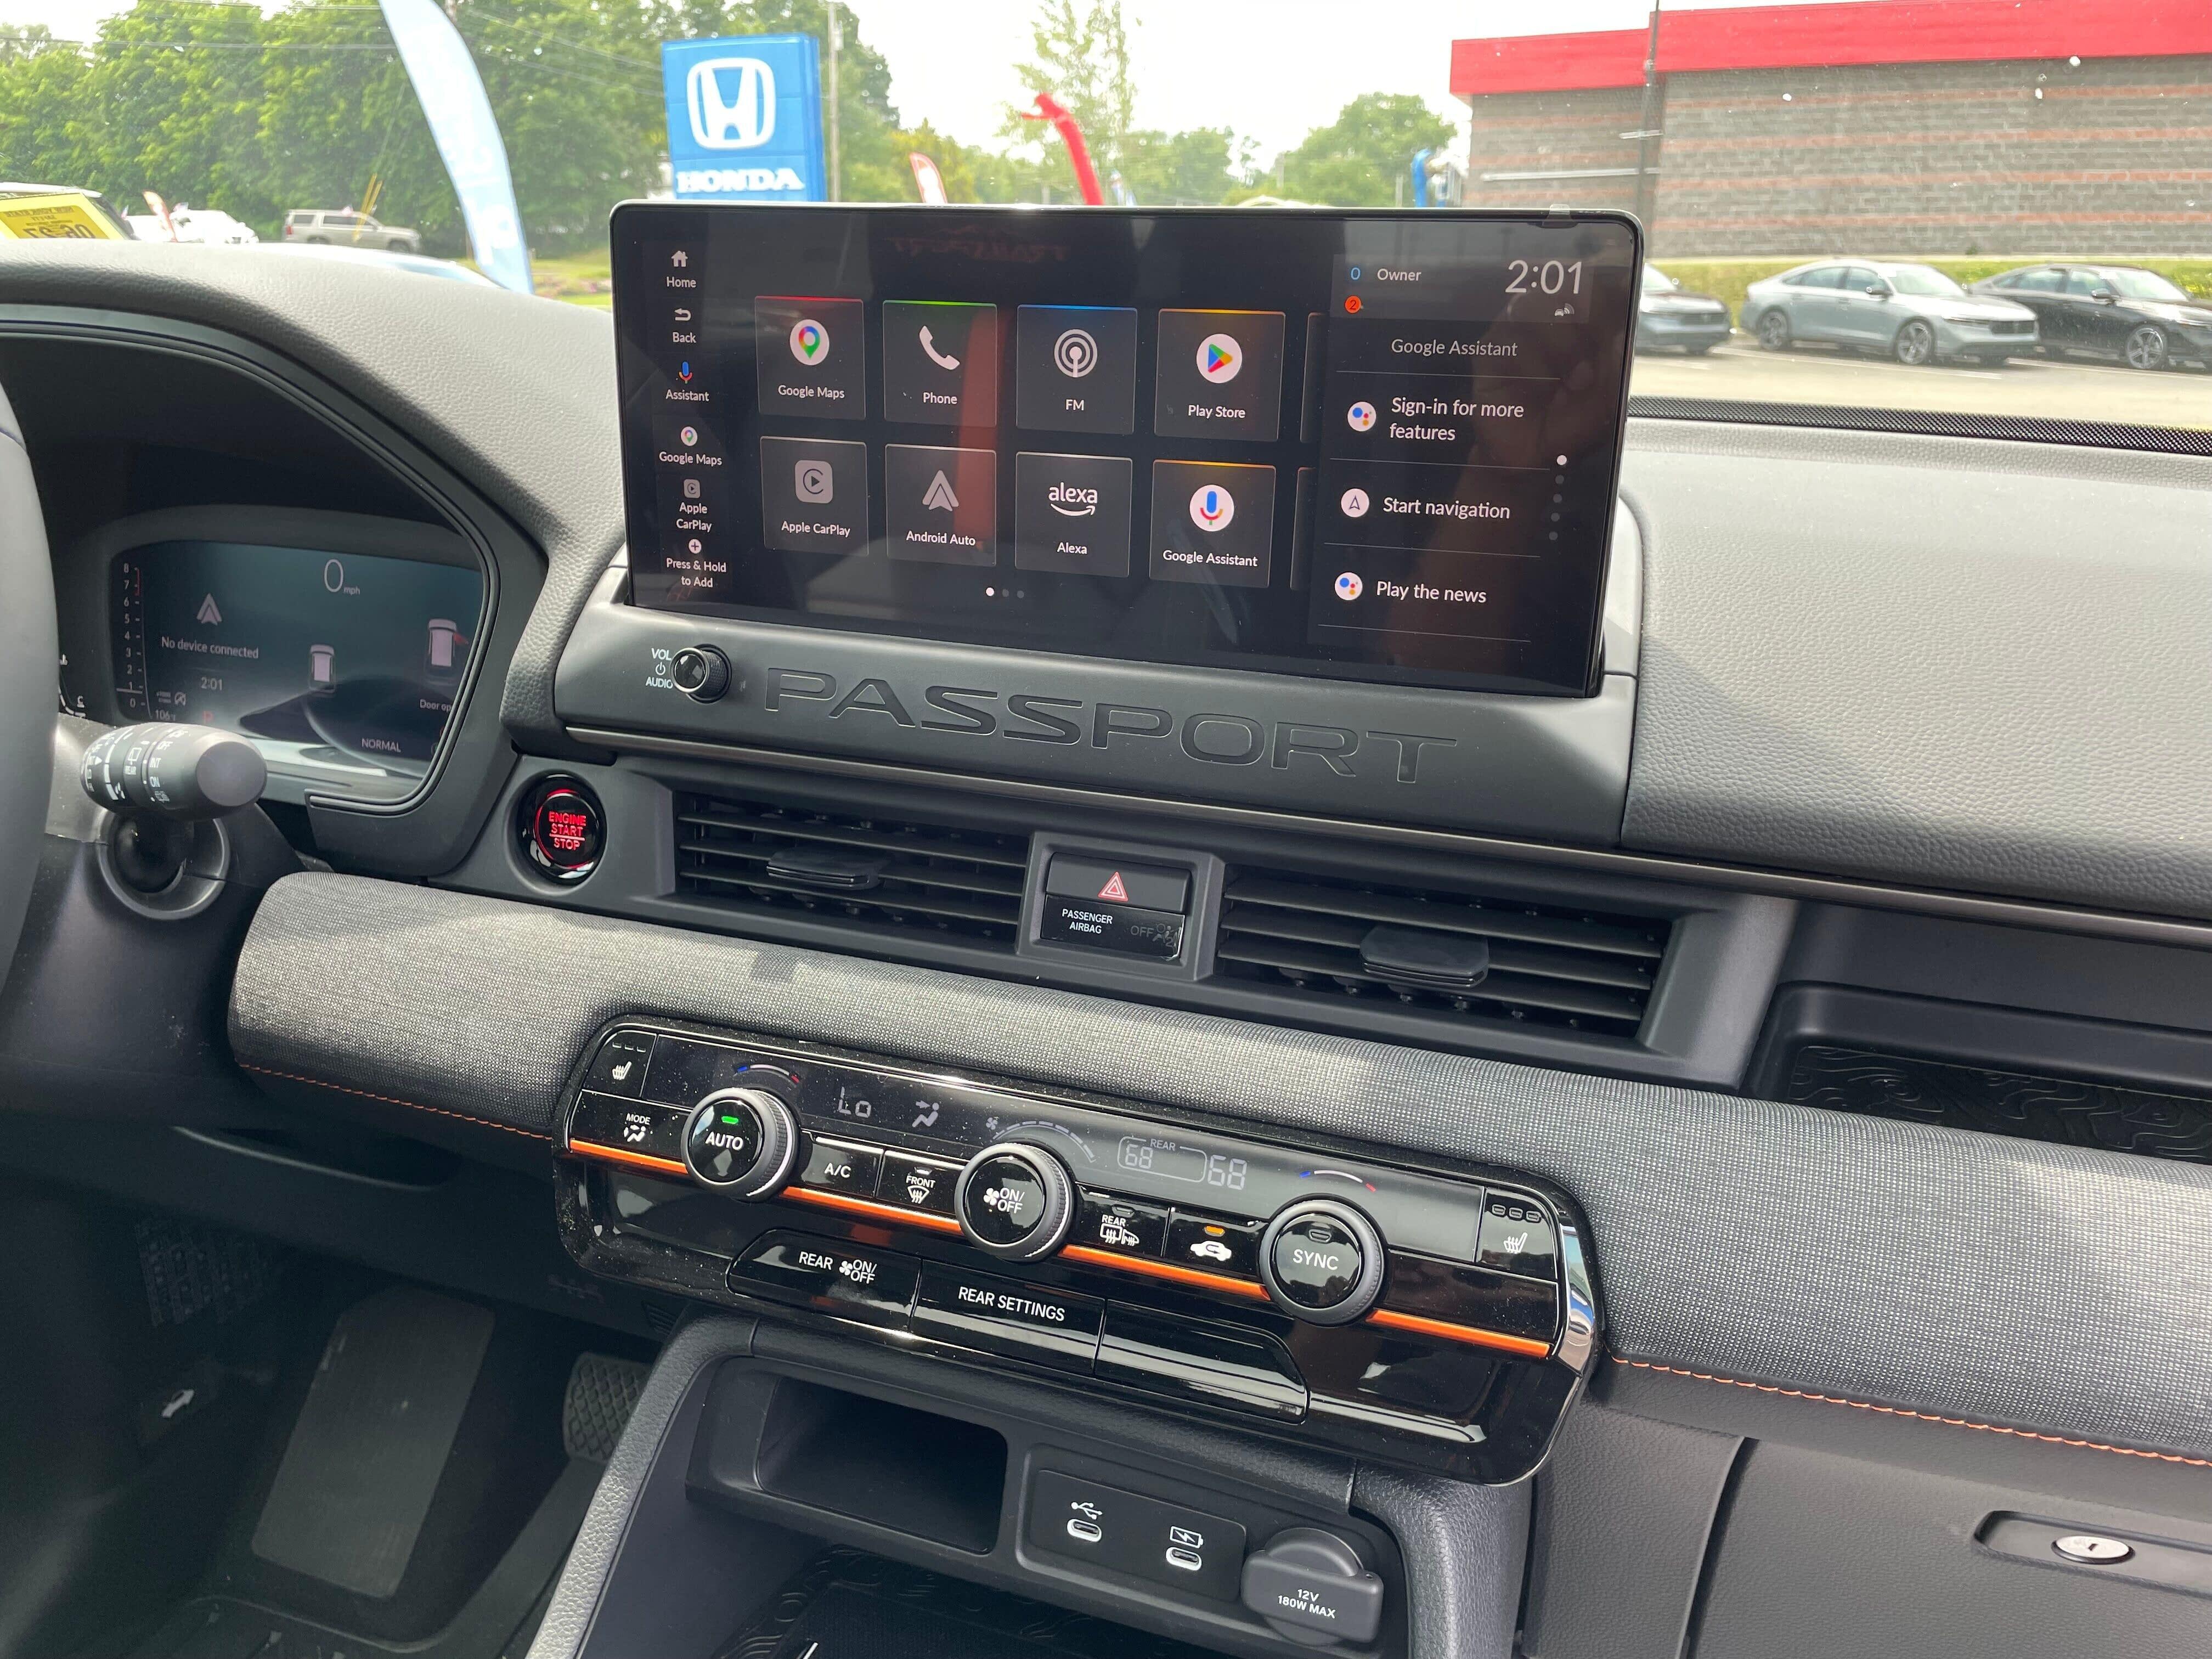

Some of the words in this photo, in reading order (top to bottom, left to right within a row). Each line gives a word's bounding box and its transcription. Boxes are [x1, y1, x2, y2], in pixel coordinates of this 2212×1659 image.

[676, 168, 805, 193] HONDA
[1377, 268, 1421, 281] Owner
[1505, 260, 1582, 295] 2:01
[666, 276, 697, 288] Home
[673, 331, 697, 343] Back
[1391, 338, 1445, 357] Google
[1449, 340, 1517, 357] Assistant
[665, 389, 709, 402] Assistant
[778, 385, 814, 398] Google
[817, 387, 845, 400] Maps
[923, 392, 957, 404] Phone
[1065, 399, 1085, 411] FM
[1188, 404, 1212, 418] Play
[1216, 406, 1245, 419] Store
[1392, 396, 1447, 416] Sign-in
[1453, 399, 1476, 415] for
[1481, 403, 1524, 418] more
[1390, 423, 1456, 441] features
[659, 452, 693, 465] Google
[696, 454, 723, 466] Maps
[1048, 482, 1098, 504] alexa
[679, 502, 708, 515] Apple
[1383, 497, 1421, 514] Start
[1425, 500, 1510, 520] navigation
[676, 518, 712, 533] CarPlay
[781, 521, 811, 534] Apple
[813, 523, 850, 538] CarPlay
[906, 530, 947, 544] Android
[950, 534, 976, 546] Auto
[1057, 541, 1087, 555] Alexa
[666, 557, 691, 570] Press
[693, 560, 701, 570] &
[704, 561, 727, 573] Hold
[1163, 550, 1203, 564] Google
[1206, 552, 1258, 567] Assistant
[123, 563, 129, 573] 8
[324, 558, 343, 592] 0
[343, 586, 360, 595] mph
[681, 575, 691, 586] to
[693, 577, 713, 588] Add
[124, 580, 129, 590] 7
[1376, 581, 1409, 601] Play
[1414, 583, 1440, 600] the
[1444, 589, 1487, 603] news
[123, 597, 129, 607] 6
[124, 613, 130, 624] 5
[124, 631, 130, 640] 4
[126, 647, 131, 658] 3
[162, 636, 175, 649] No
[177, 638, 208, 653] device
[210, 644, 258, 659] connected
[651, 648, 672, 661] VOL
[127, 664, 132, 675] 2
[201, 676, 223, 691] 2:01
[645, 676, 673, 689] AUDIO
[129, 698, 136, 708] 0
[420, 698, 439, 710] Door
[764, 668, 1458, 783] PASSPORT
[362, 737, 401, 753] NORMAL
[149, 758, 161, 768] INT
[150, 776, 161, 787] ON
[549, 811, 586, 826] ENGINE
[551, 823, 584, 837] START
[554, 837, 580, 850] STOP
[1062, 908, 1113, 924] PASSENGER
[1069, 922, 1102, 934] AIRBAG
[1130, 926, 1154, 938] OFF
[626, 1113, 651, 1125] MODE
[706, 1131, 744, 1151] AUTO
[1150, 1138, 1176, 1152] REAR
[824, 1163, 851, 1178] A/C
[1125, 1143, 1153, 1170] 68
[1207, 1154, 1248, 1190] 68
[906, 1175, 936, 1188] FRONT
[1000, 1187, 1025, 1201] ON/
[997, 1199, 1023, 1214] OFF
[1102, 1214, 1126, 1227] REAR
[798, 1251, 833, 1270] REAR
[853, 1259, 877, 1273] ON/
[1293, 1249, 1339, 1271] SYNC
[850, 1270, 875, 1284] OFF
[958, 1286, 995, 1307] REAR
[997, 1295, 1065, 1322] SETTINGS
[1297, 1589, 1319, 1602] 12V
[1277, 1594, 1307, 1611] 180W
[1308, 1604, 1336, 1619] MAX
